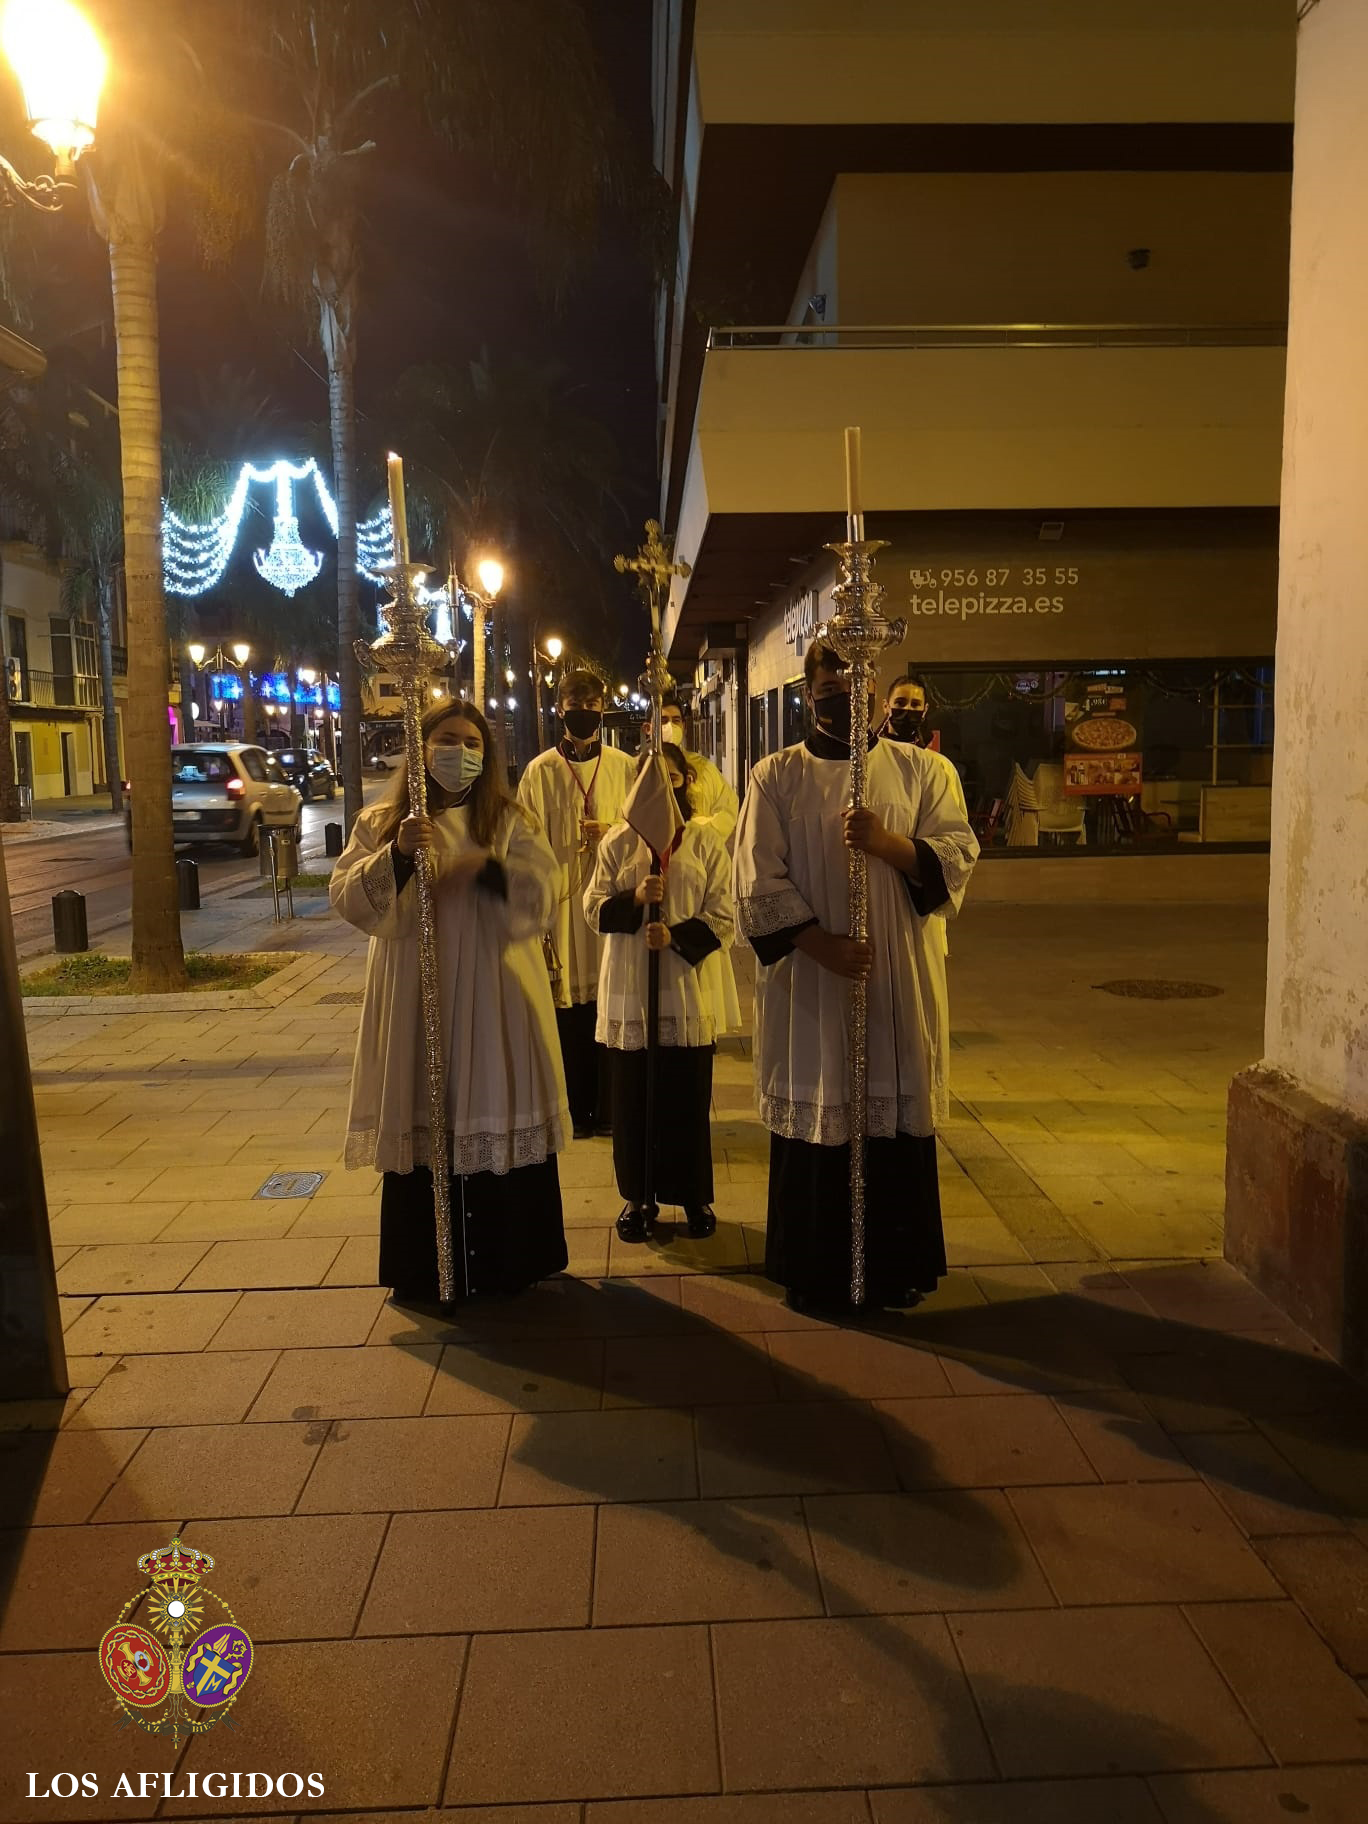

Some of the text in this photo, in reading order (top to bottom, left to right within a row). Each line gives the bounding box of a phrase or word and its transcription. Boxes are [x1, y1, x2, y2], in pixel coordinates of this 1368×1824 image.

[940, 568, 1079, 586] 956 87 35 55
[910, 590, 1064, 621] telepizza.es
